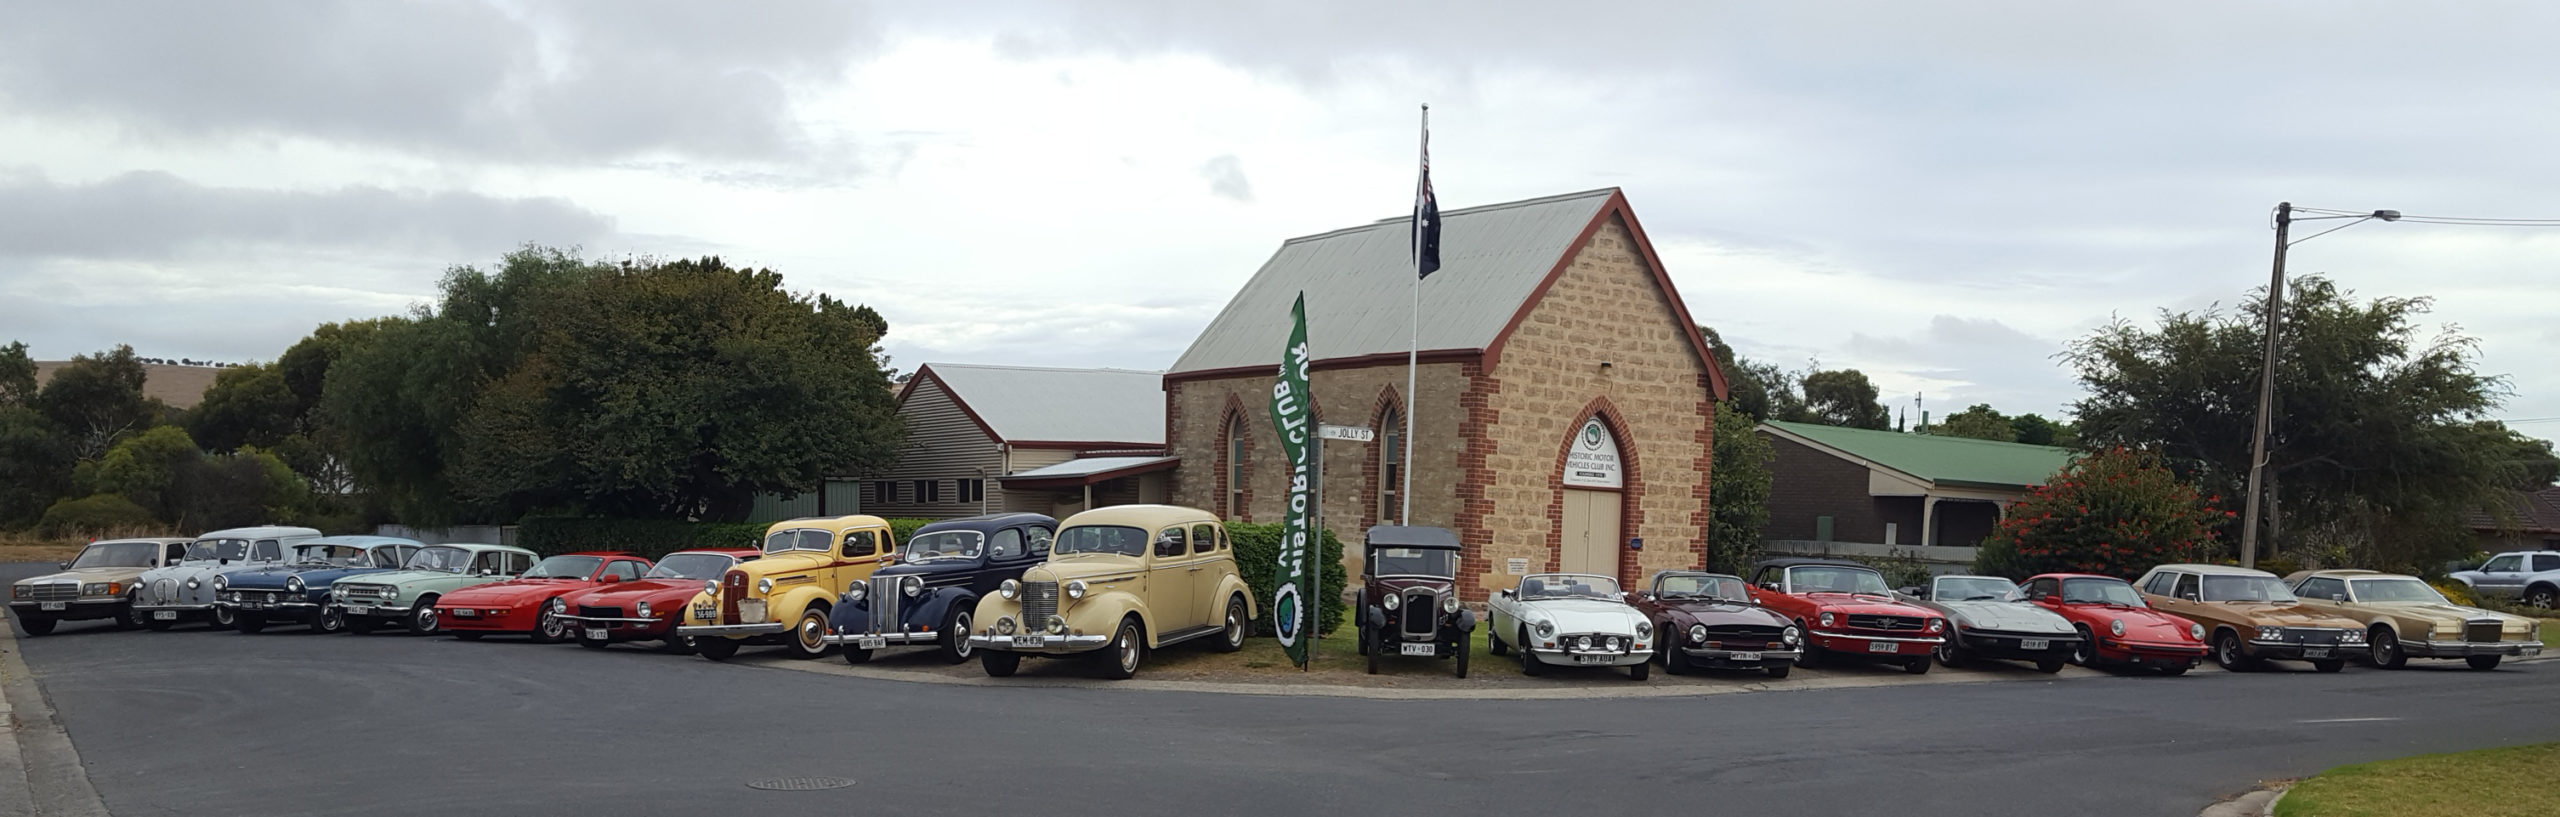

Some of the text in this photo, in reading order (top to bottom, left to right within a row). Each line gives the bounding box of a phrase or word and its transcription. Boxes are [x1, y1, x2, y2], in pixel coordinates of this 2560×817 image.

[1338, 428, 1369, 439] JOLLY ST
[1569, 452, 1615, 461] HISTORIC MOTOR
[1566, 460, 1590, 470] VEHICLES
[1590, 462, 1604, 470] CLUB
